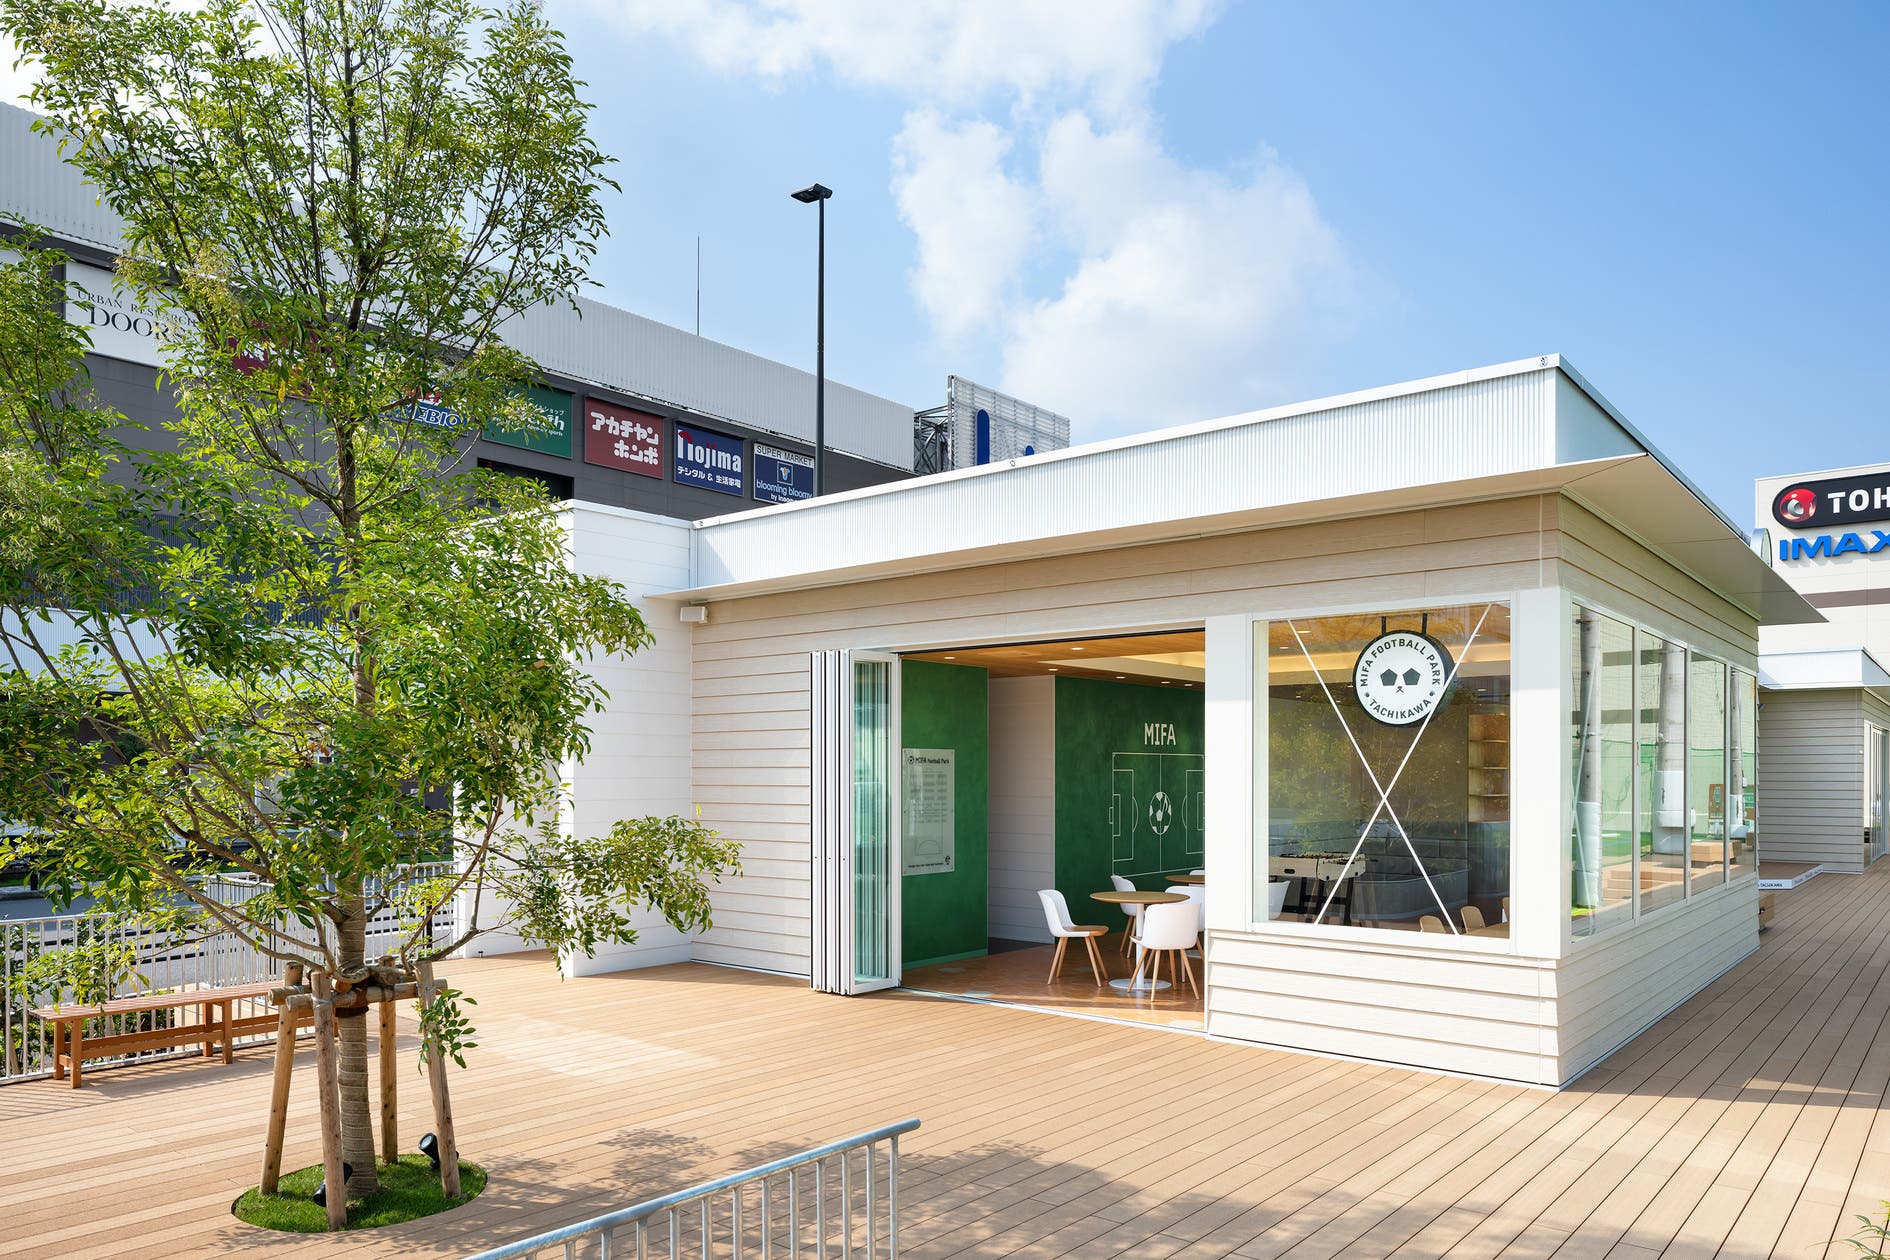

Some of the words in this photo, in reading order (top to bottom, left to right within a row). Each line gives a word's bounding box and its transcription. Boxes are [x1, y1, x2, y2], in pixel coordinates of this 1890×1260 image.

[77, 290, 122, 309] URBAN
[90, 307, 183, 343] DOOR
[590, 411, 659, 446] アカチャン
[756, 445, 782, 459] SUPER
[784, 452, 813, 467] MARKET
[707, 472, 714, 482] &
[756, 479, 788, 496] blooming
[770, 493, 778, 502] by
[1779, 530, 1890, 561] IMAX
[1360, 659, 1374, 687] MIFA
[1371, 638, 1426, 658] FOOTBALL
[1426, 654, 1441, 685] PARK
[1369, 698, 1432, 719] TACHIKAWA
[1144, 722, 1177, 746] MIFA
